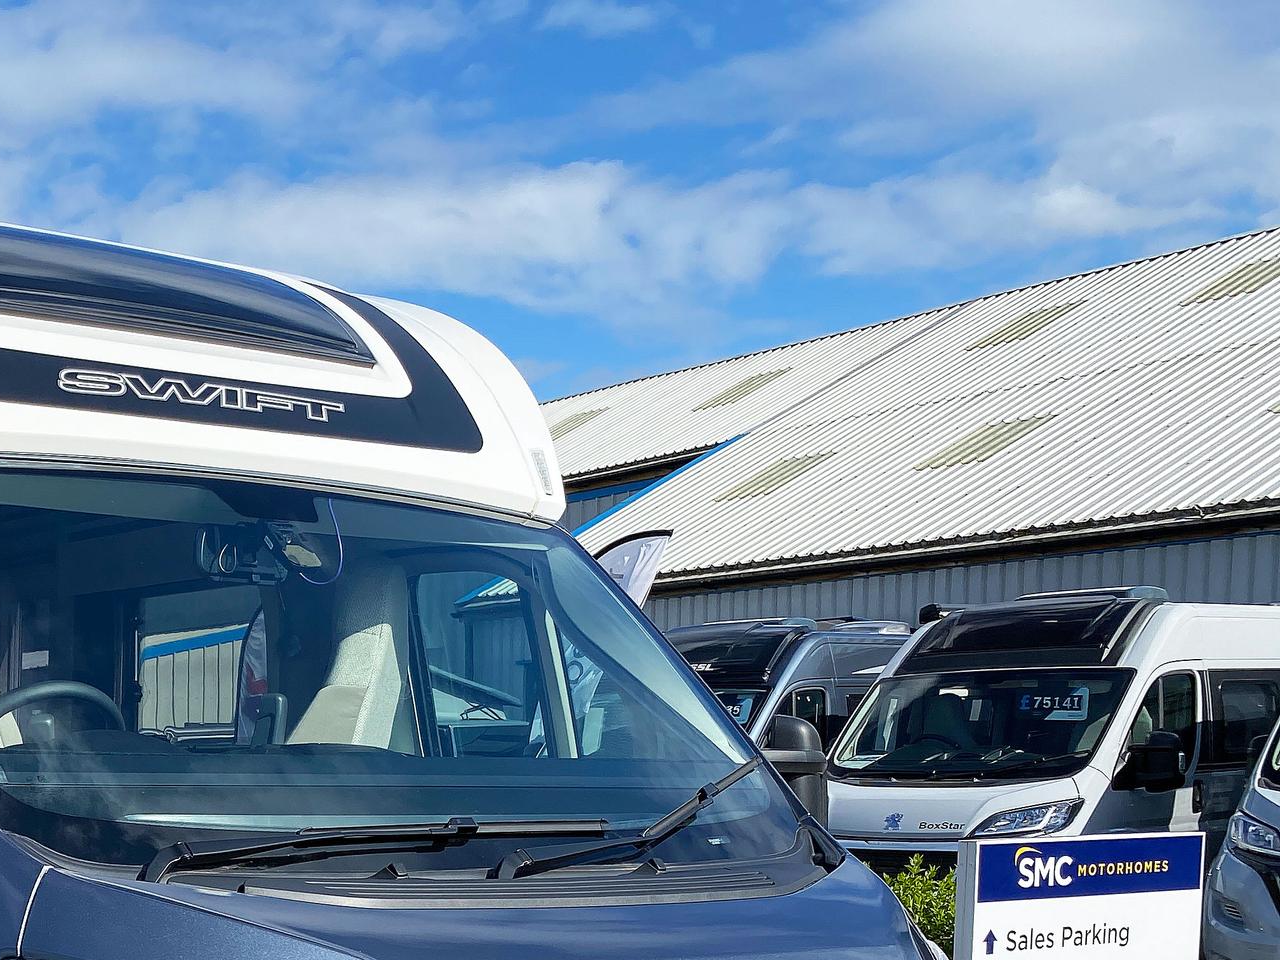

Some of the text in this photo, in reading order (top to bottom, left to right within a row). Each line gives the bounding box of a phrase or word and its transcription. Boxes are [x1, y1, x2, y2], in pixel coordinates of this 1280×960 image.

[57, 368, 345, 422] SWIFT
[690, 663, 714, 671] SSL
[918, 821, 966, 830] BoxStar
[1017, 854, 1169, 888] SMC MOTORHOMES
[1006, 923, 1130, 951] Sales Parking
